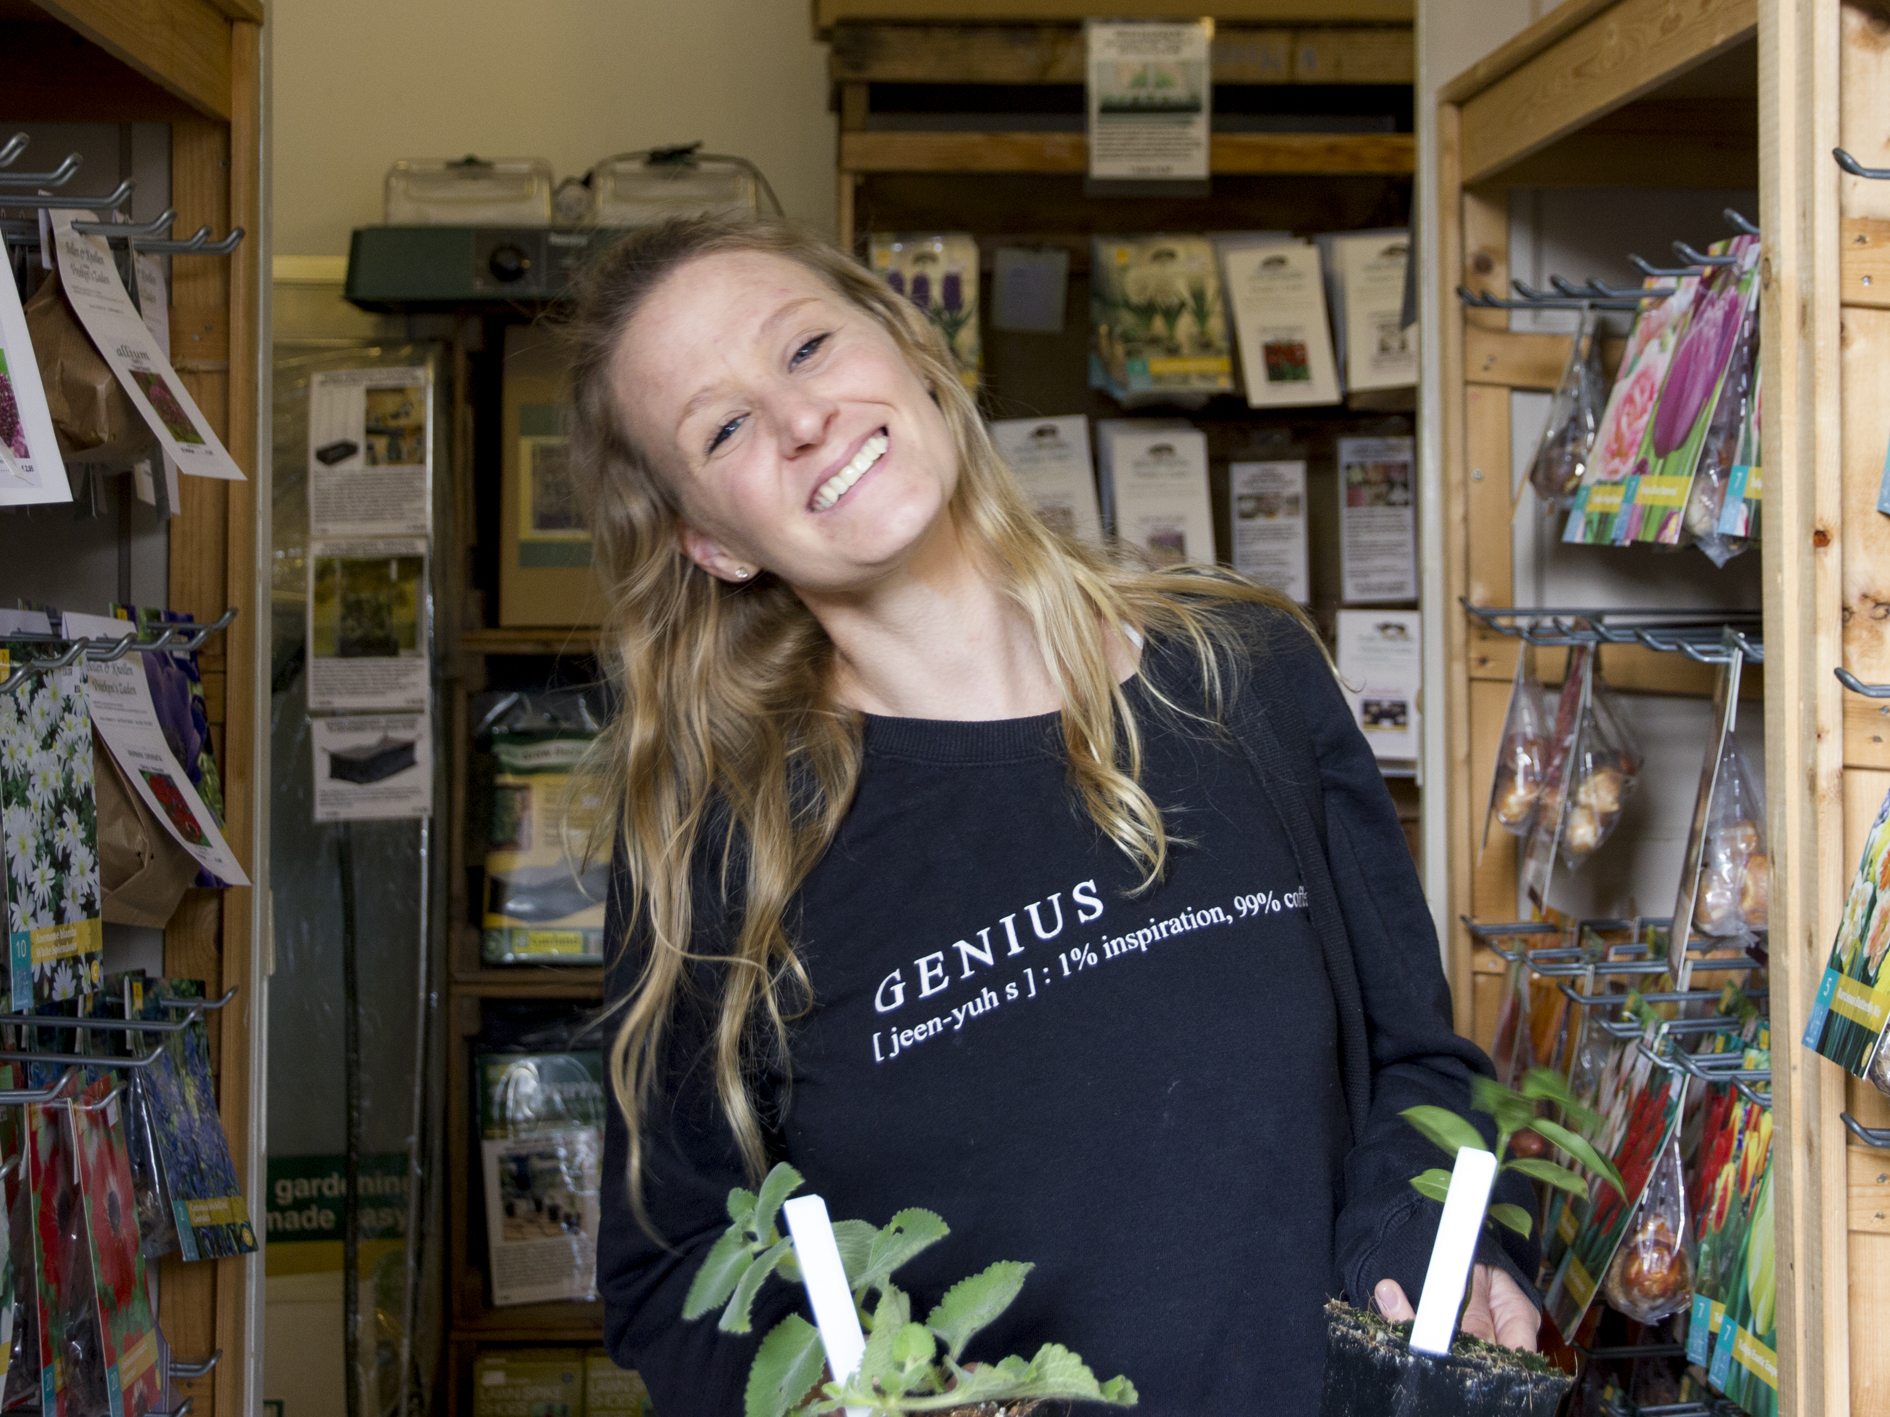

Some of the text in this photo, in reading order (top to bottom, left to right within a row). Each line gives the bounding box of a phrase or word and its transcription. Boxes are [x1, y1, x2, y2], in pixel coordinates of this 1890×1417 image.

[116, 344, 151, 360] allium
[1058, 942, 1099, 977] 1%
[1101, 906, 1234, 960] inspiration,
[1233, 889, 1282, 919] 99%
[16, 938, 27, 958] 10
[874, 878, 1104, 1013] GENIUS
[1823, 977, 1833, 997] 5
[273, 1170, 411, 1207] gardning
[359, 1205, 410, 1235] asy
[1697, 1302, 1705, 1319] 7
[1723, 1324, 1732, 1342] 7
